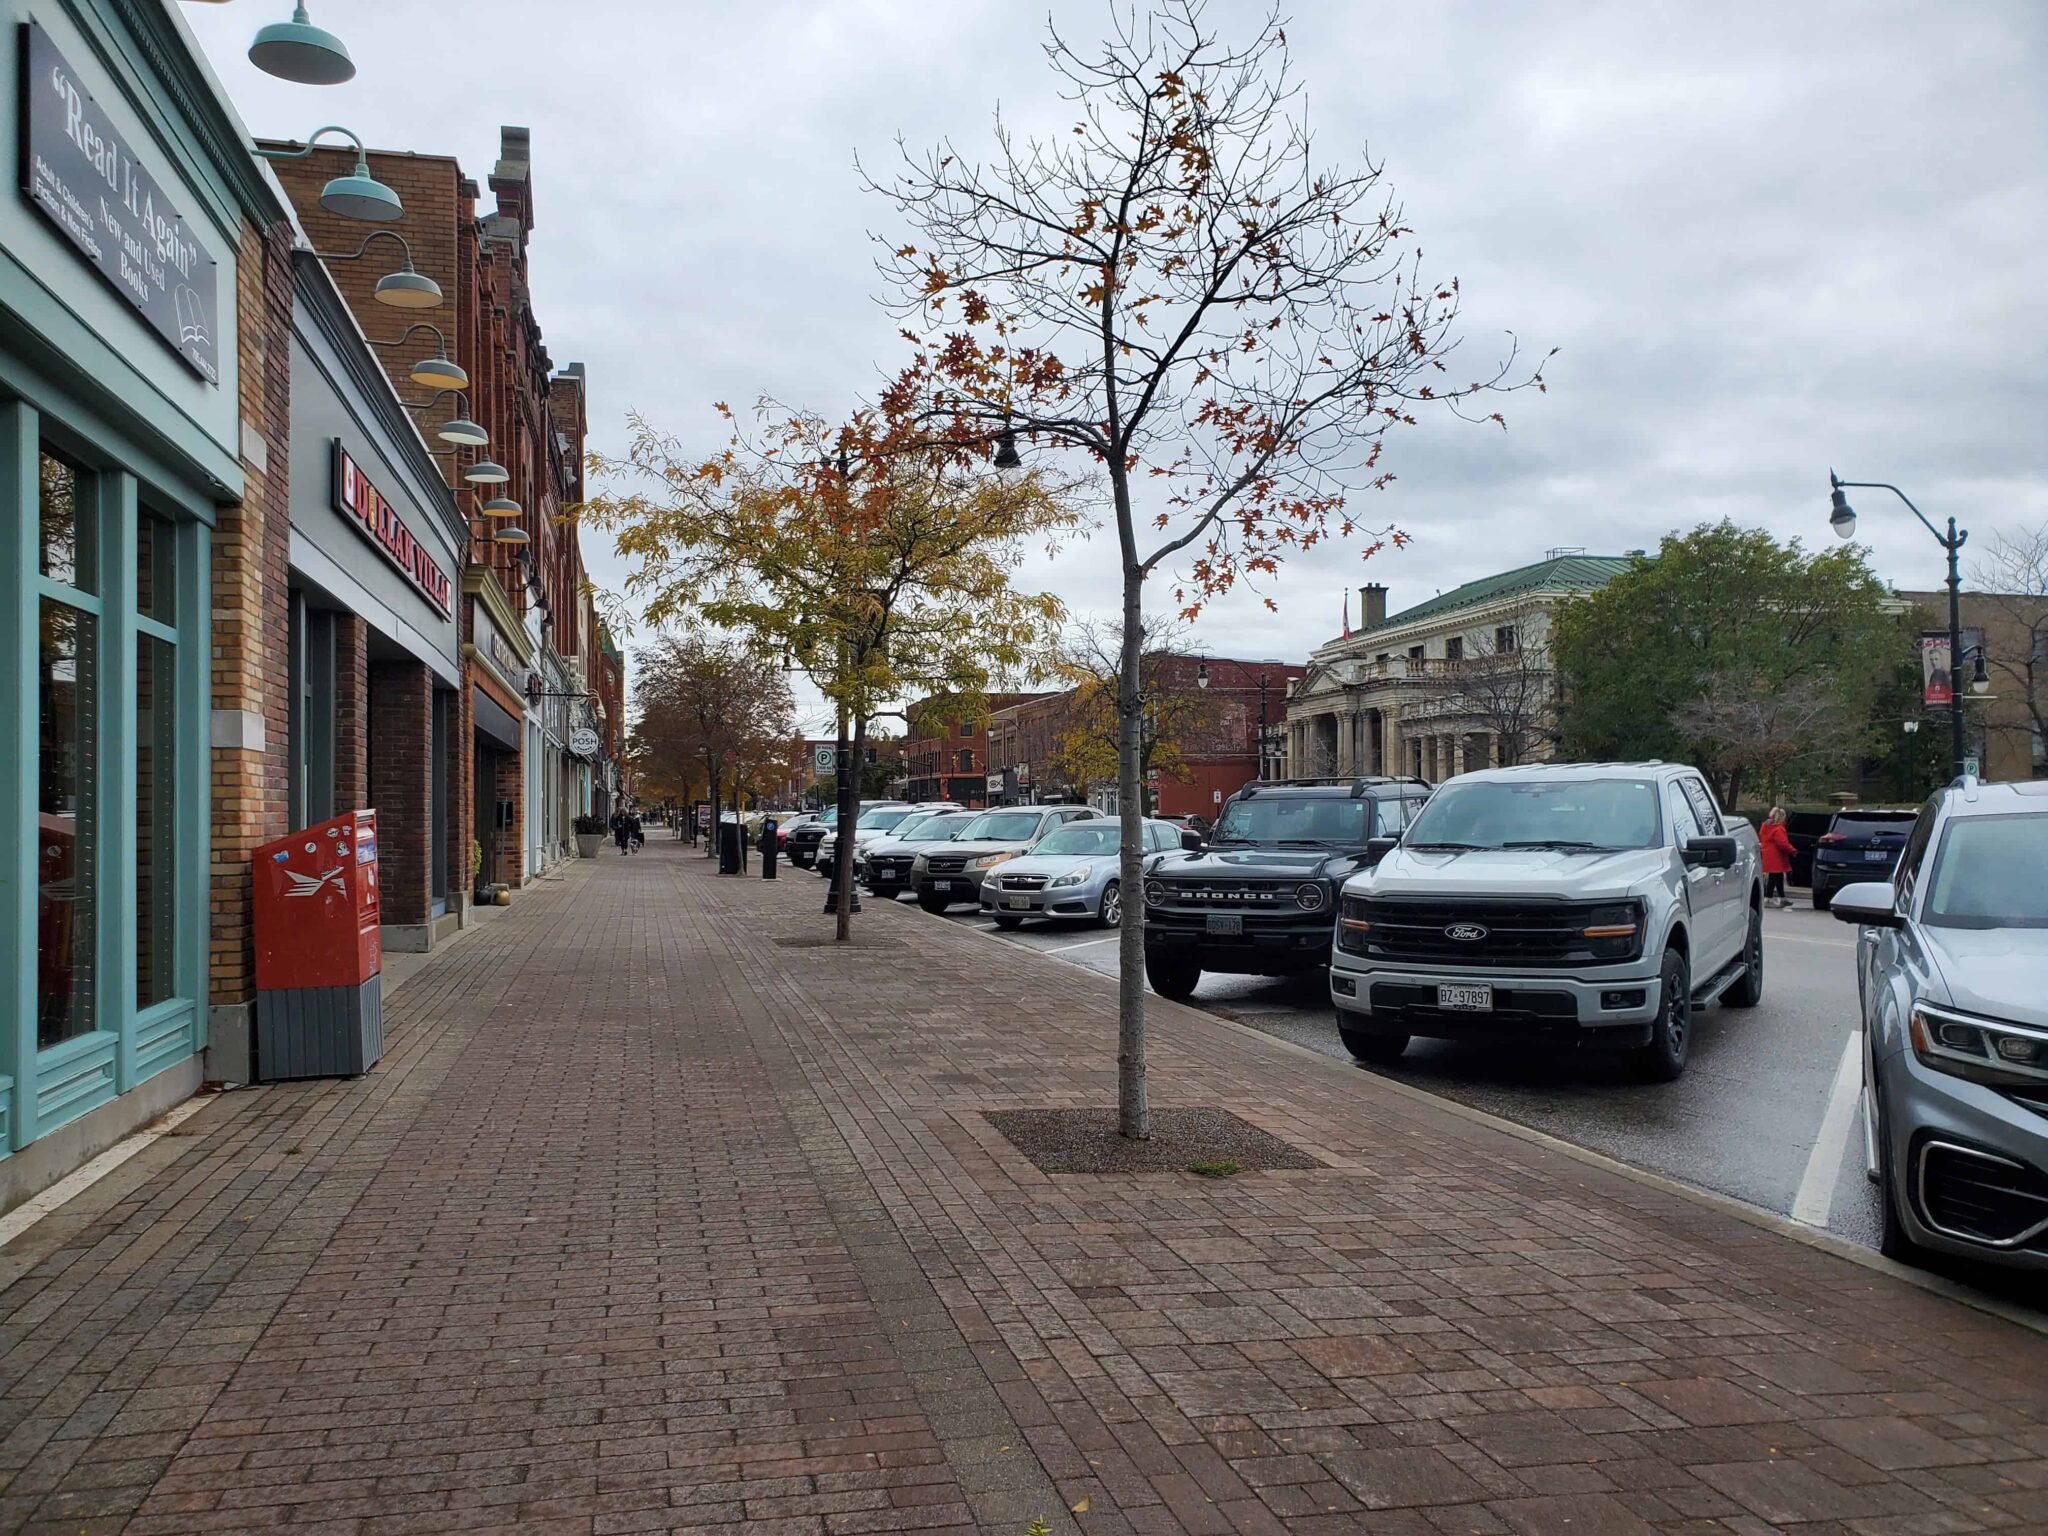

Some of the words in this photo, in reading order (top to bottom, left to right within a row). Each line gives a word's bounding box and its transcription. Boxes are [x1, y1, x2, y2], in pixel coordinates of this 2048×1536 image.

[36, 155, 55, 187] Adult
[56, 177, 62, 195] &
[123, 156, 140, 218] It
[36, 176, 60, 215] Fiction
[61, 204, 67, 222] &
[67, 211, 81, 238] Non
[81, 227, 103, 261] Fiction
[100, 195, 122, 242] New
[124, 232, 142, 267] and
[143, 247, 166, 292] Used
[120, 251, 149, 302] Books
[572, 737, 597, 745] POSH
[1181, 892, 1273, 900] BRONCO
[1452, 926, 1479, 939] Ford
[1440, 989, 1453, 1003] BZ
[1459, 990, 1490, 1005] 97897
